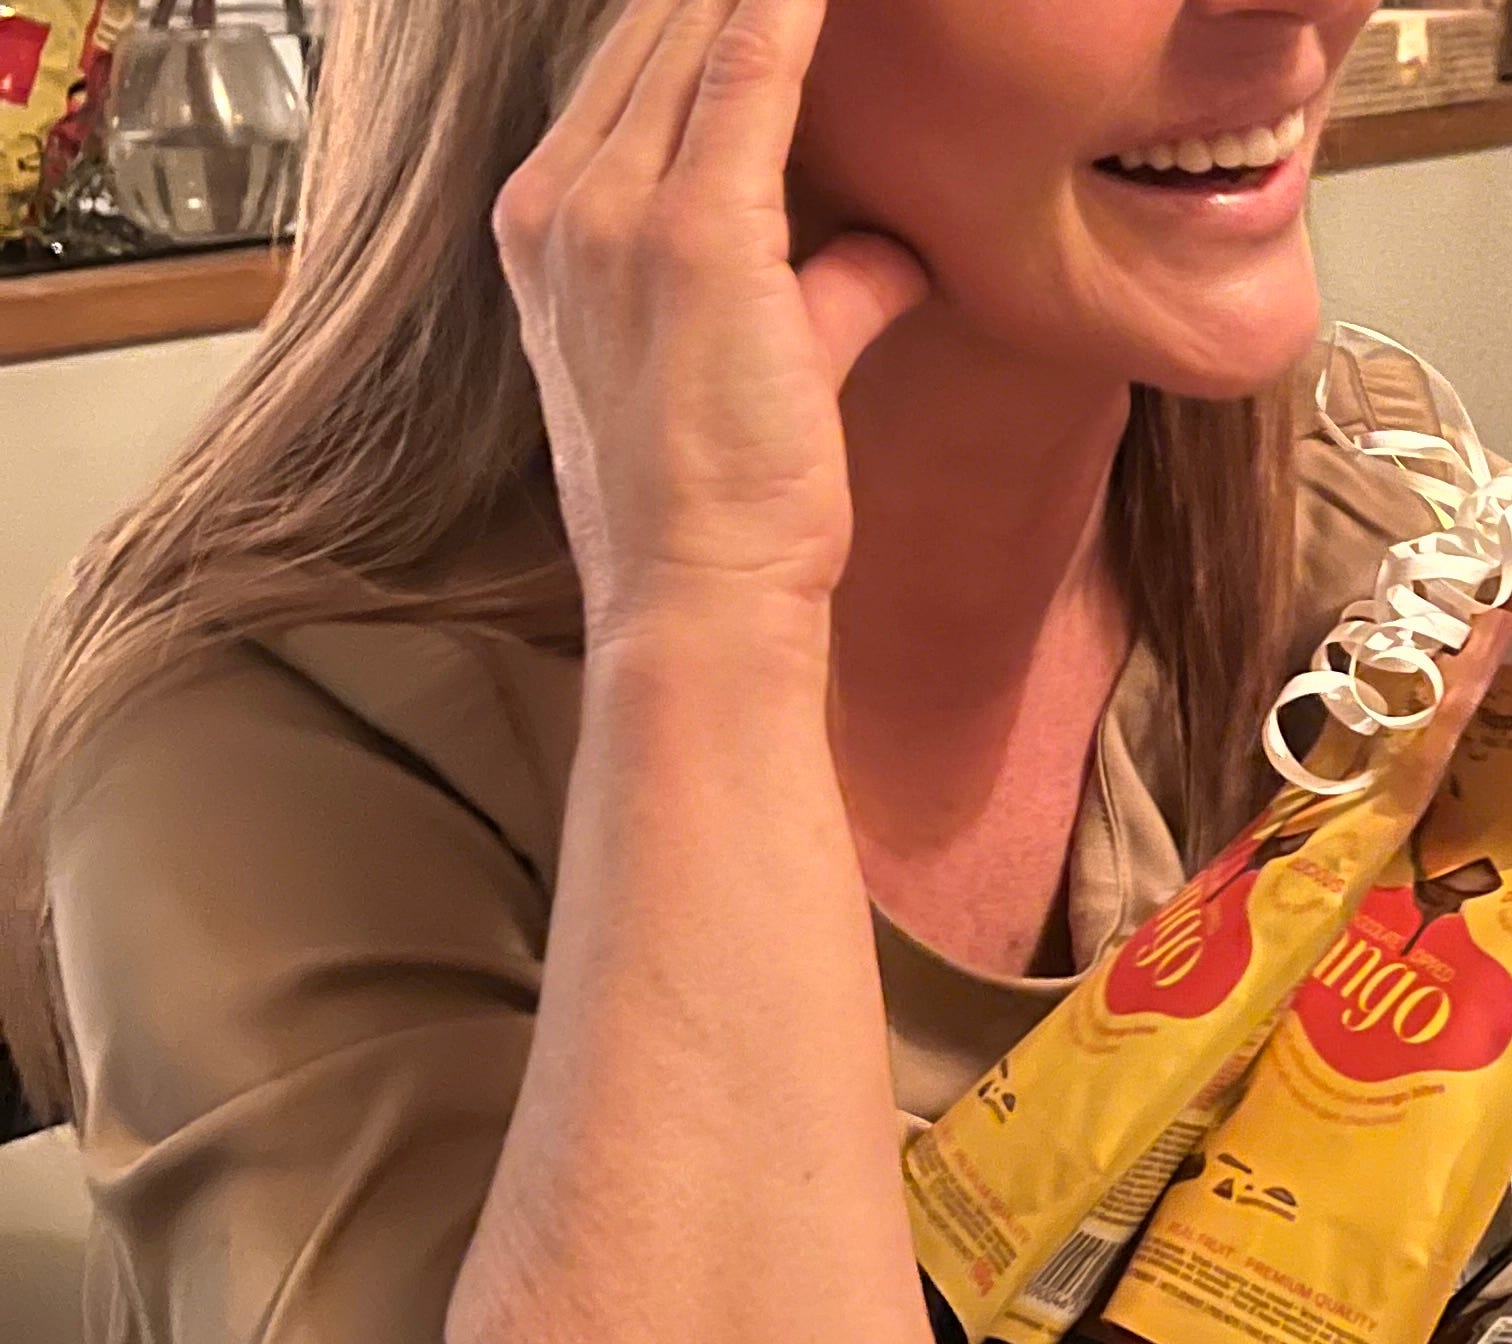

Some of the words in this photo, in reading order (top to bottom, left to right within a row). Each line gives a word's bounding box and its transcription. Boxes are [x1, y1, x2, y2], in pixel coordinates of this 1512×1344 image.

[1312, 928, 1453, 1045] ngo
[1244, 1256, 1314, 1300] PREMIUM
[1314, 1291, 1379, 1333] QUALITY
